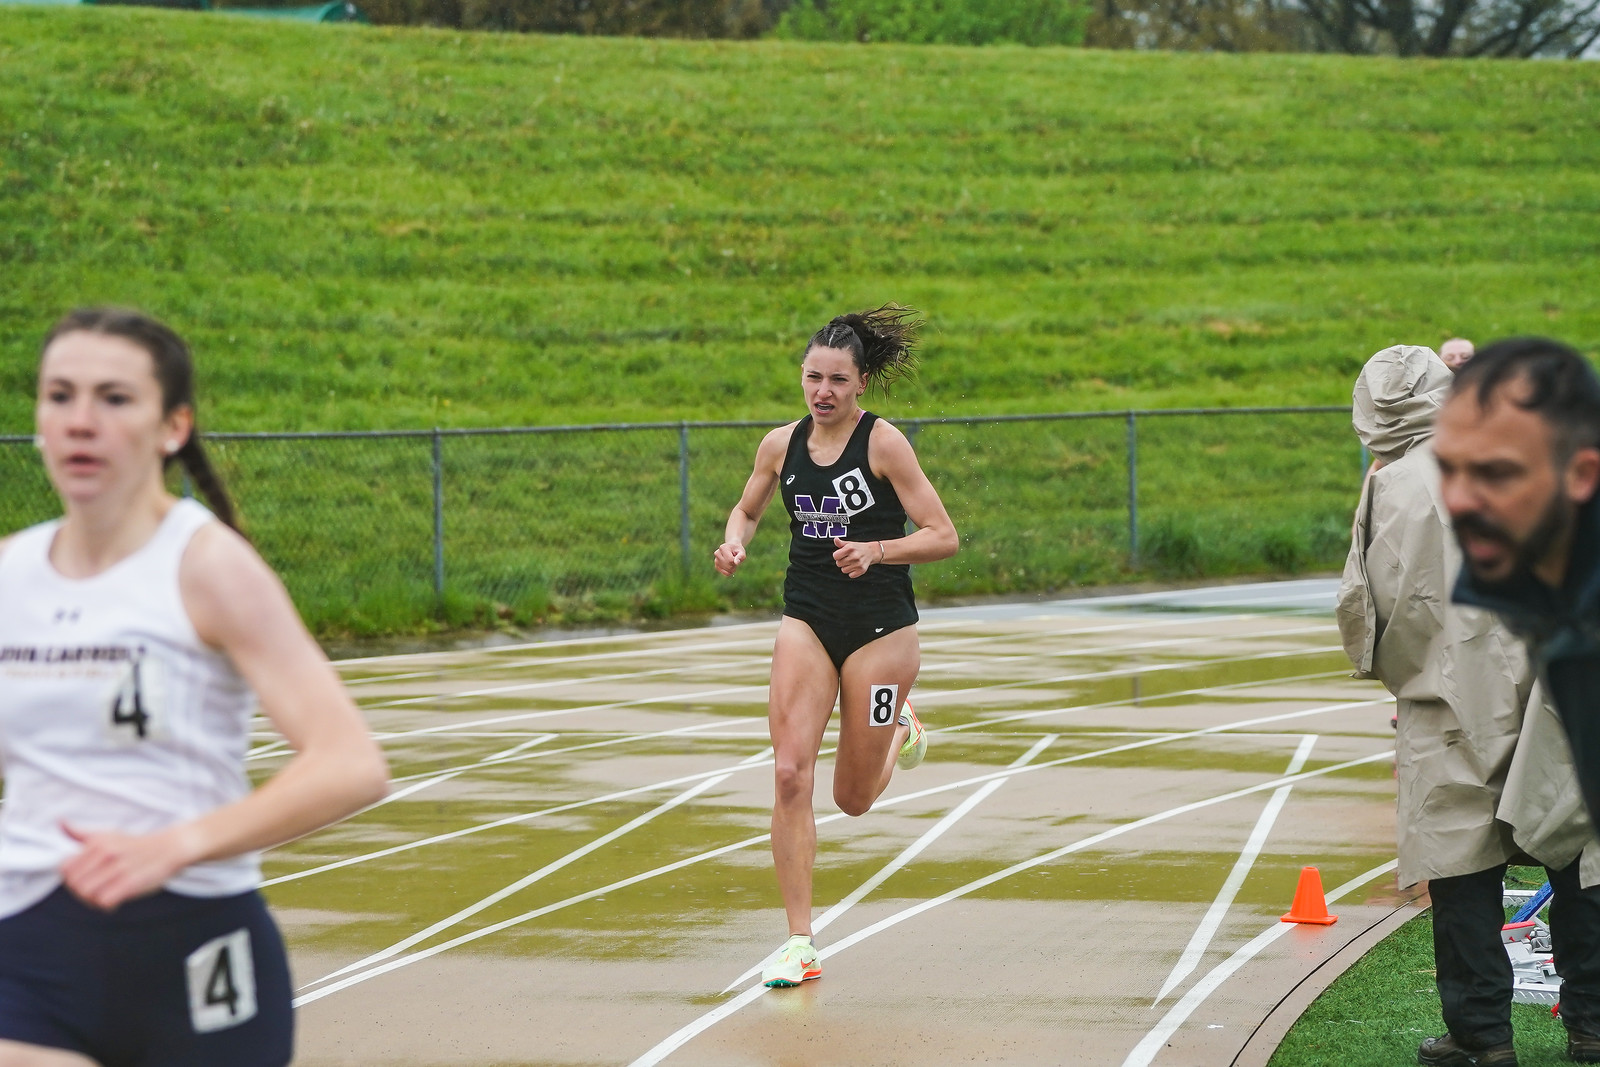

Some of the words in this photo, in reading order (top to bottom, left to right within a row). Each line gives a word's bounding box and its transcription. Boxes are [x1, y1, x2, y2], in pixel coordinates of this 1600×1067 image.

[839, 476, 868, 511] 8
[795, 494, 847, 539] M
[112, 661, 149, 738] 4
[873, 688, 893, 724] 8
[204, 945, 240, 1016] 4
